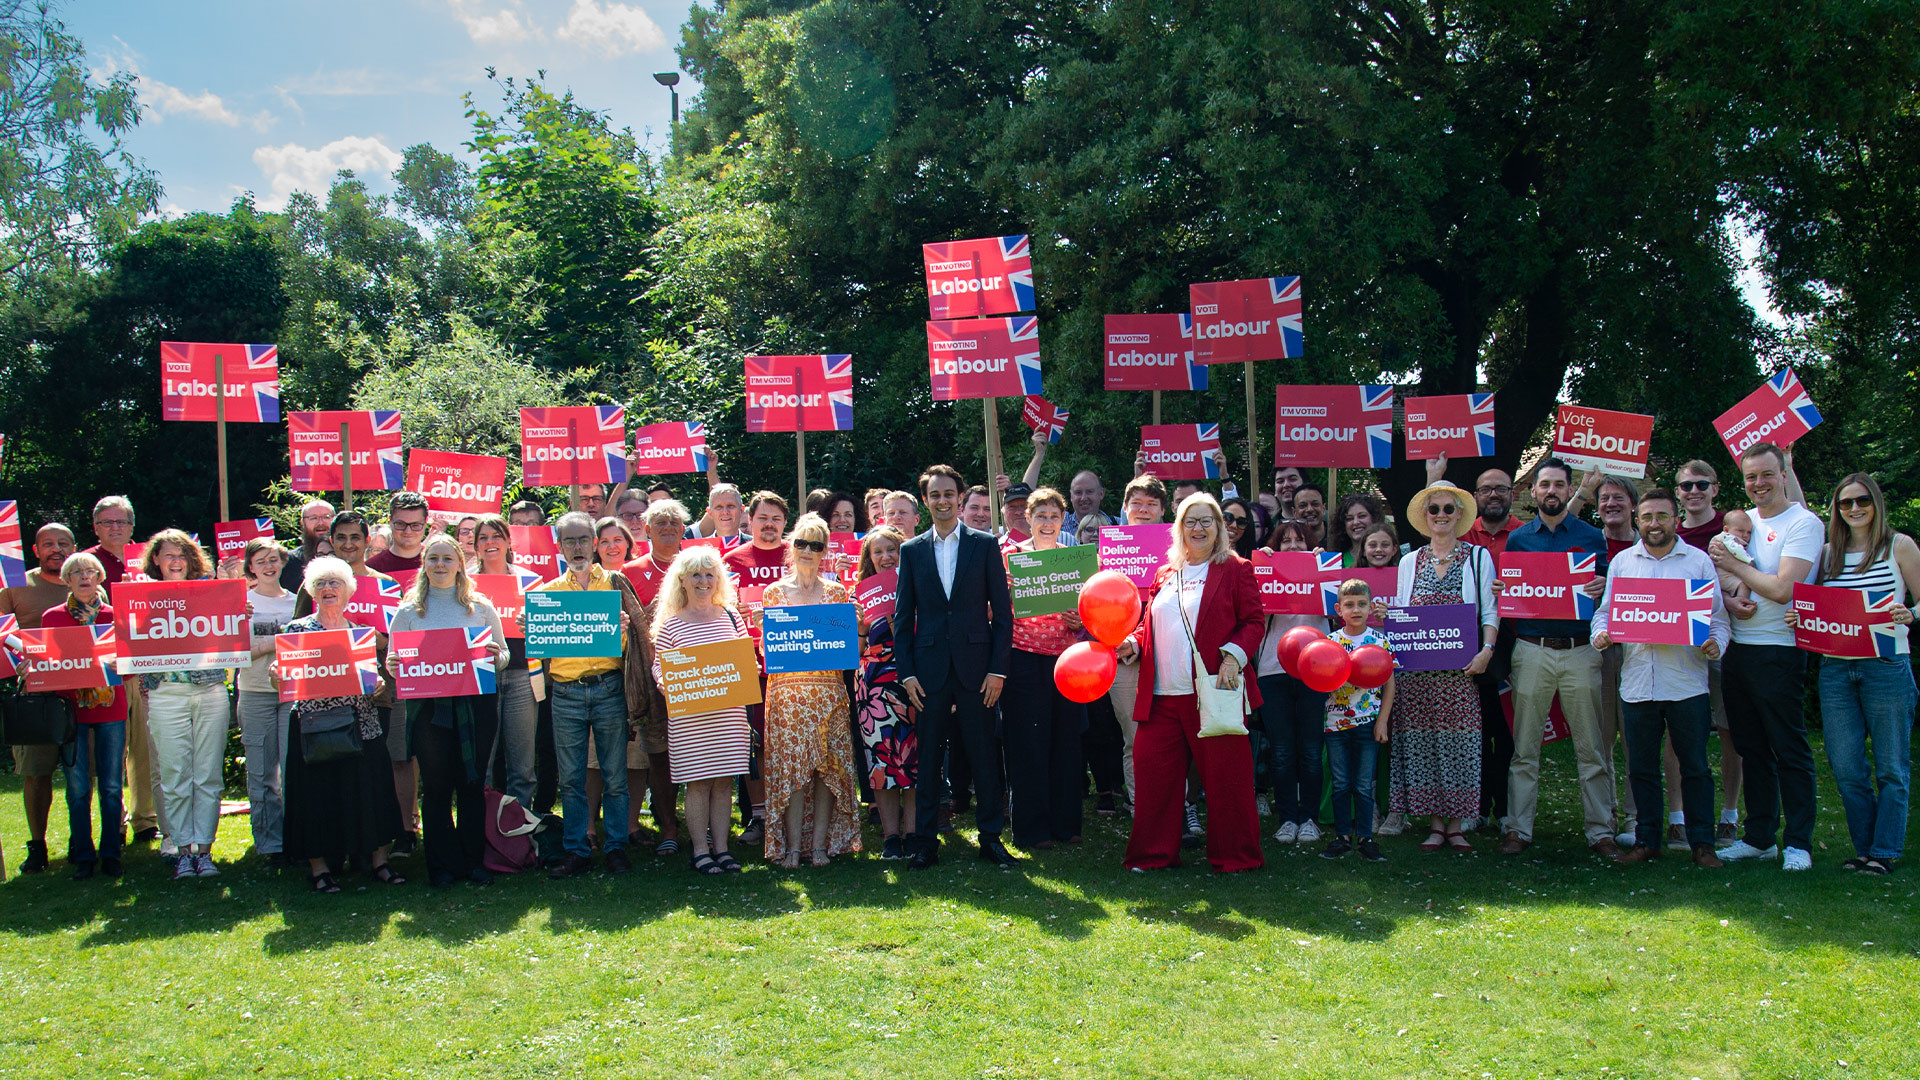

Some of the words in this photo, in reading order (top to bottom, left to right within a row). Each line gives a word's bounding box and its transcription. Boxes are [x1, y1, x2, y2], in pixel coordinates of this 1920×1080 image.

[944, 262, 970, 270] VOTING
[931, 276, 1002, 296] Labour
[1196, 320, 1270, 340] Labour
[947, 341, 976, 349] VOTING
[934, 356, 1009, 375] Labour
[1108, 349, 1178, 367] Labour
[167, 379, 246, 397] Labour
[750, 391, 822, 408] Labour
[1024, 404, 1049, 428] Labour
[1562, 410, 1595, 427] Vote
[1280, 423, 1358, 442] Labour
[1408, 426, 1468, 440] Labour
[1724, 430, 1735, 438] I'M
[1734, 414, 1757, 431] VOTING
[1729, 410, 1786, 457] Labour
[1557, 426, 1646, 456] Labour
[295, 448, 371, 466] Labour
[526, 443, 596, 462] Labour
[638, 446, 687, 459] Labour
[1145, 450, 1196, 463] Labour
[420, 464, 434, 473] I'm
[435, 466, 462, 478] voting
[417, 474, 502, 502] Labour
[219, 540, 248, 551] Labo
[1102, 544, 1141, 555] Deliver
[513, 552, 551, 565] bour
[1102, 554, 1159, 566] economic
[749, 566, 789, 578] VOTE
[1013, 576, 1032, 587] Set
[1033, 575, 1048, 588] up
[1049, 569, 1080, 582] Great
[1104, 565, 1148, 578] bility
[1014, 585, 1050, 599] British
[1501, 582, 1566, 598] Labour
[129, 599, 146, 610] I'm
[149, 598, 187, 611] voting
[343, 602, 378, 613] our
[528, 611, 571, 622] Launch
[573, 613, 582, 622] a
[583, 613, 609, 622] new
[1612, 607, 1681, 624] Labour
[128, 610, 246, 640] Labour
[528, 623, 568, 633] Border
[569, 621, 618, 636] Security
[1796, 614, 1863, 637] Labour
[528, 634, 593, 645] Command
[766, 630, 788, 641] Cut
[789, 629, 814, 640] NHS
[1387, 629, 1427, 641] Recruit
[1429, 628, 1461, 641] 6,500
[766, 640, 811, 654] waiting
[812, 639, 846, 650] times
[1413, 640, 1464, 651] teachers
[28, 657, 93, 673] Labour
[132, 659, 153, 667] Vote
[159, 657, 192, 666] Labour
[207, 656, 249, 664] labour.org.uk
[282, 664, 349, 681] Labour
[399, 661, 466, 678] Labour
[665, 667, 700, 681] Crack
[702, 662, 735, 675] down
[667, 682, 682, 693] on
[684, 671, 741, 690] antisocial
[668, 686, 729, 704] behaviour
